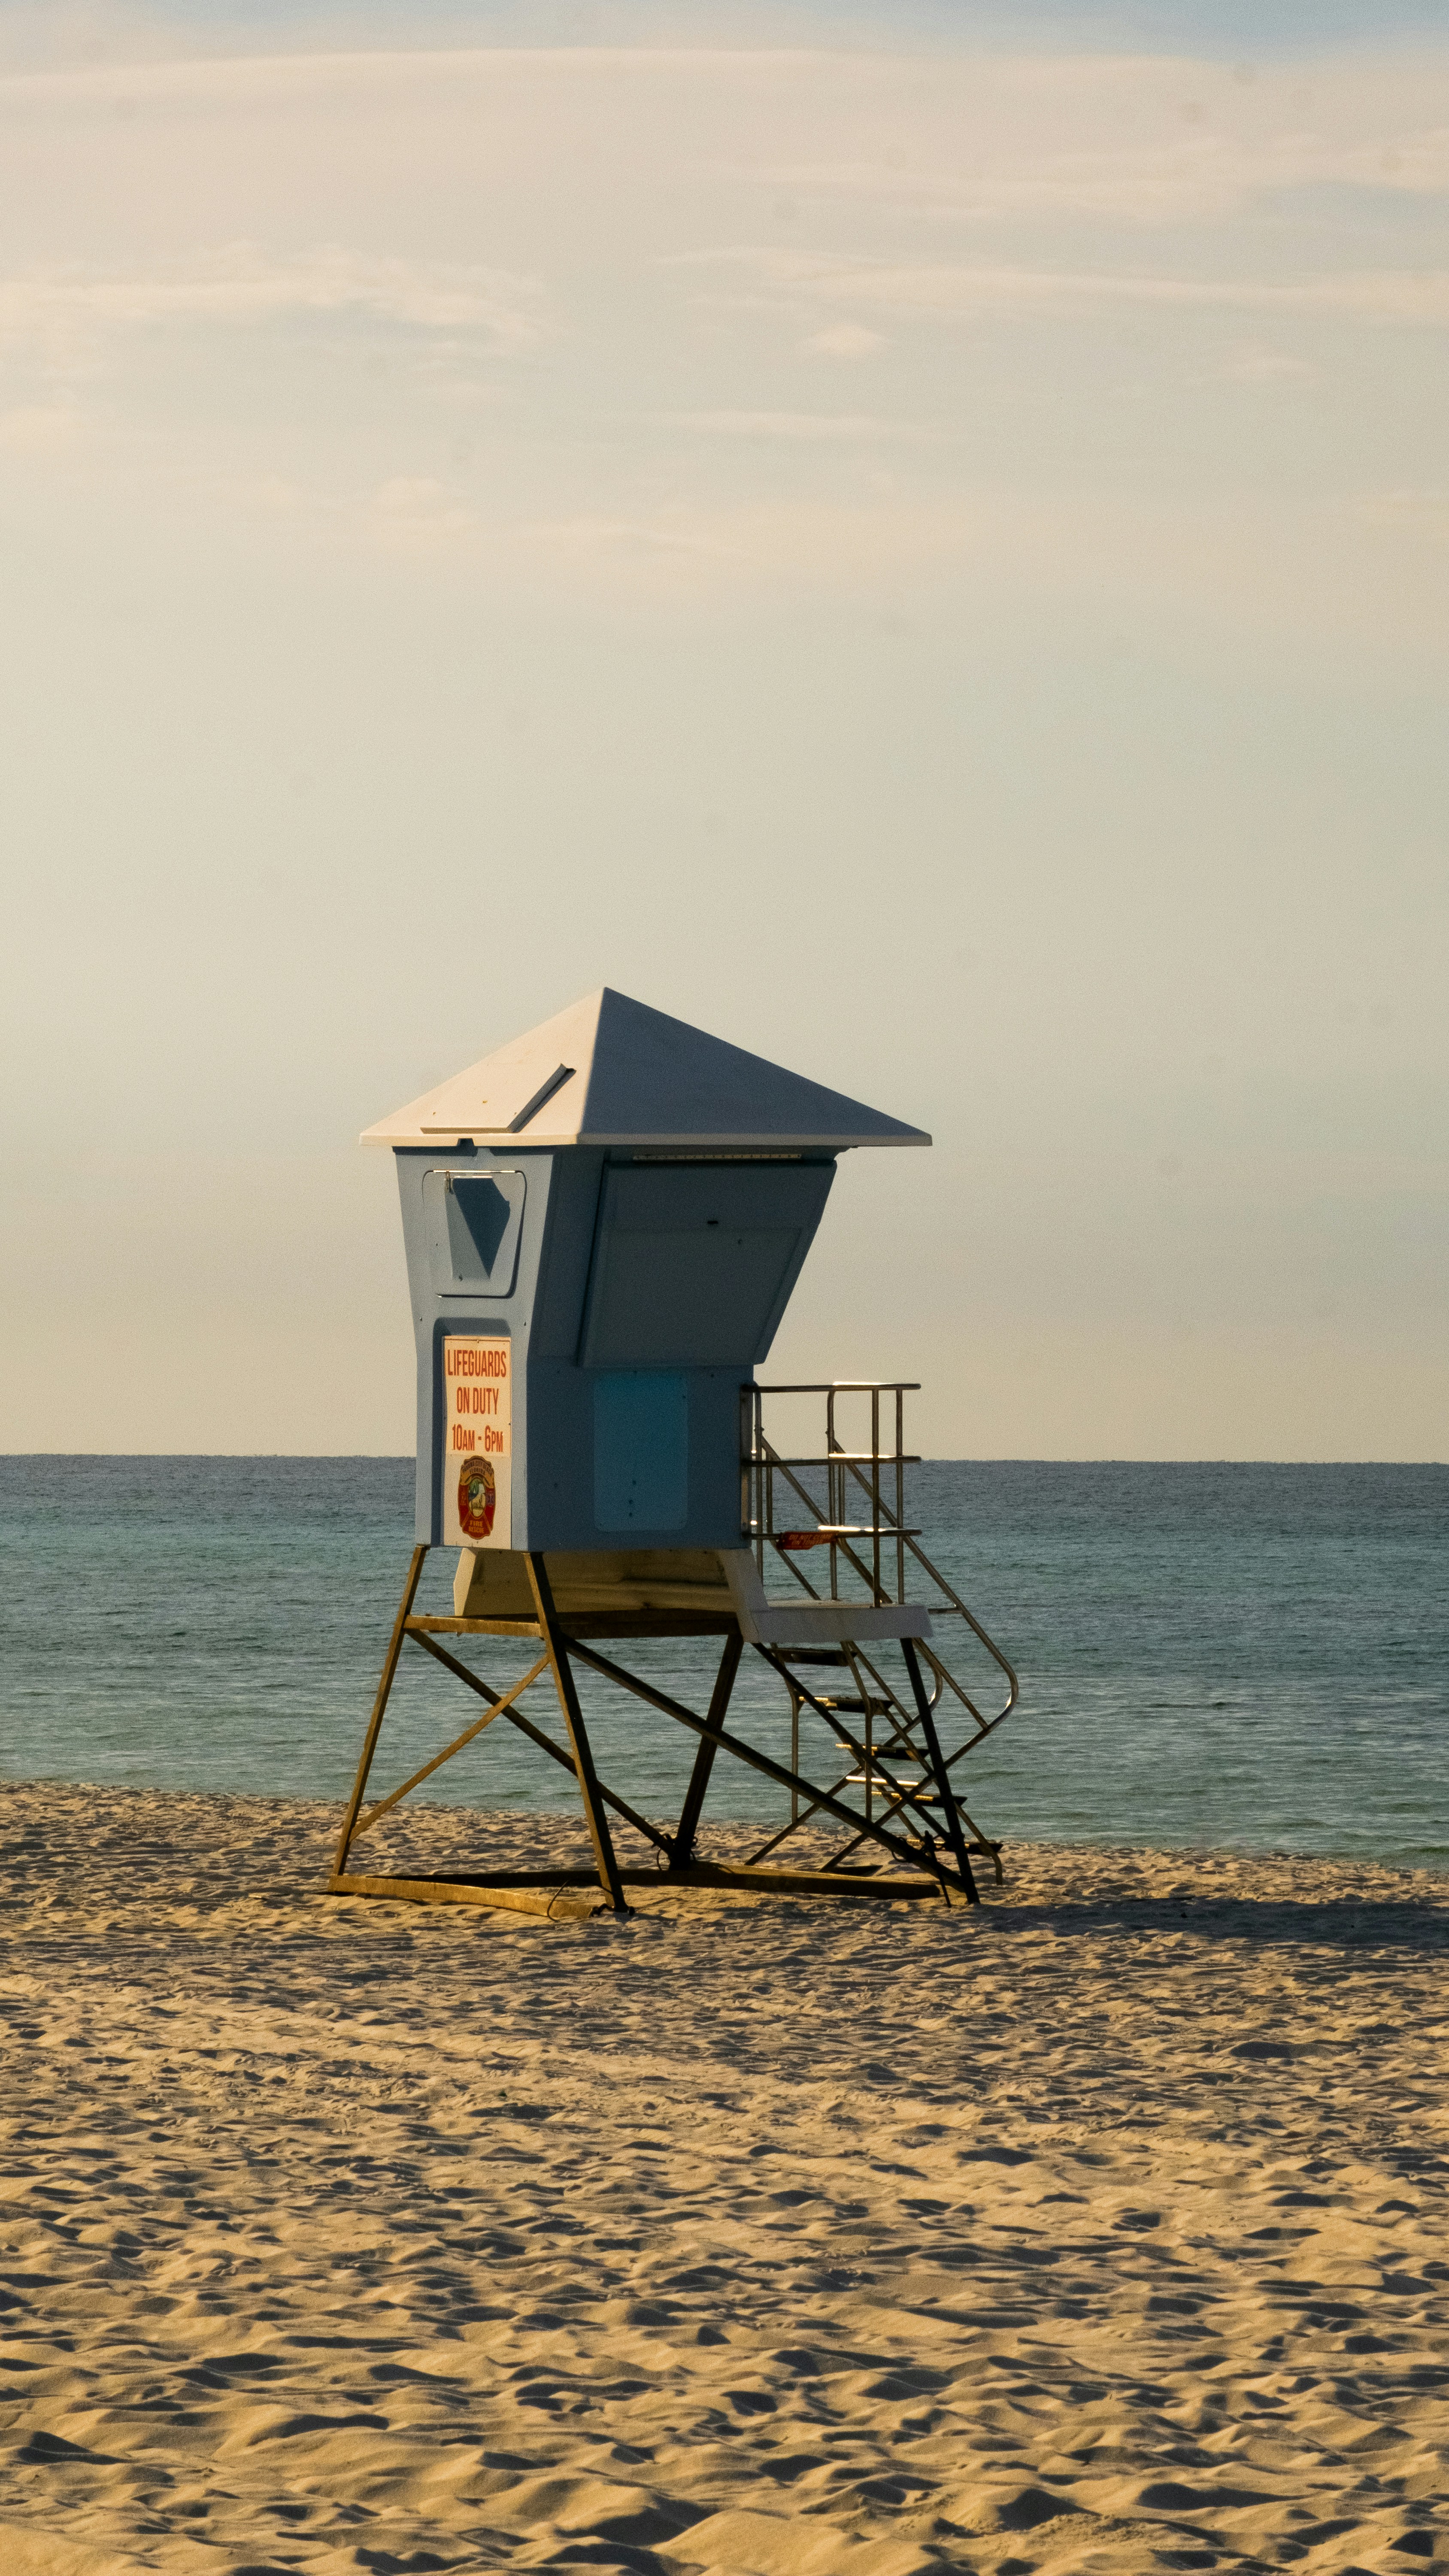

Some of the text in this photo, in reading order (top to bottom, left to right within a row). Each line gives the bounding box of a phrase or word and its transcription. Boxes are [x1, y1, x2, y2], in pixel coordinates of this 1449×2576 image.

[447, 1349, 506, 1377] LIFEGUARDS
[456, 1386, 499, 1415] ON DUTY
[452, 1424, 475, 1451] 10AM
[485, 1425, 503, 1452] 6PM
